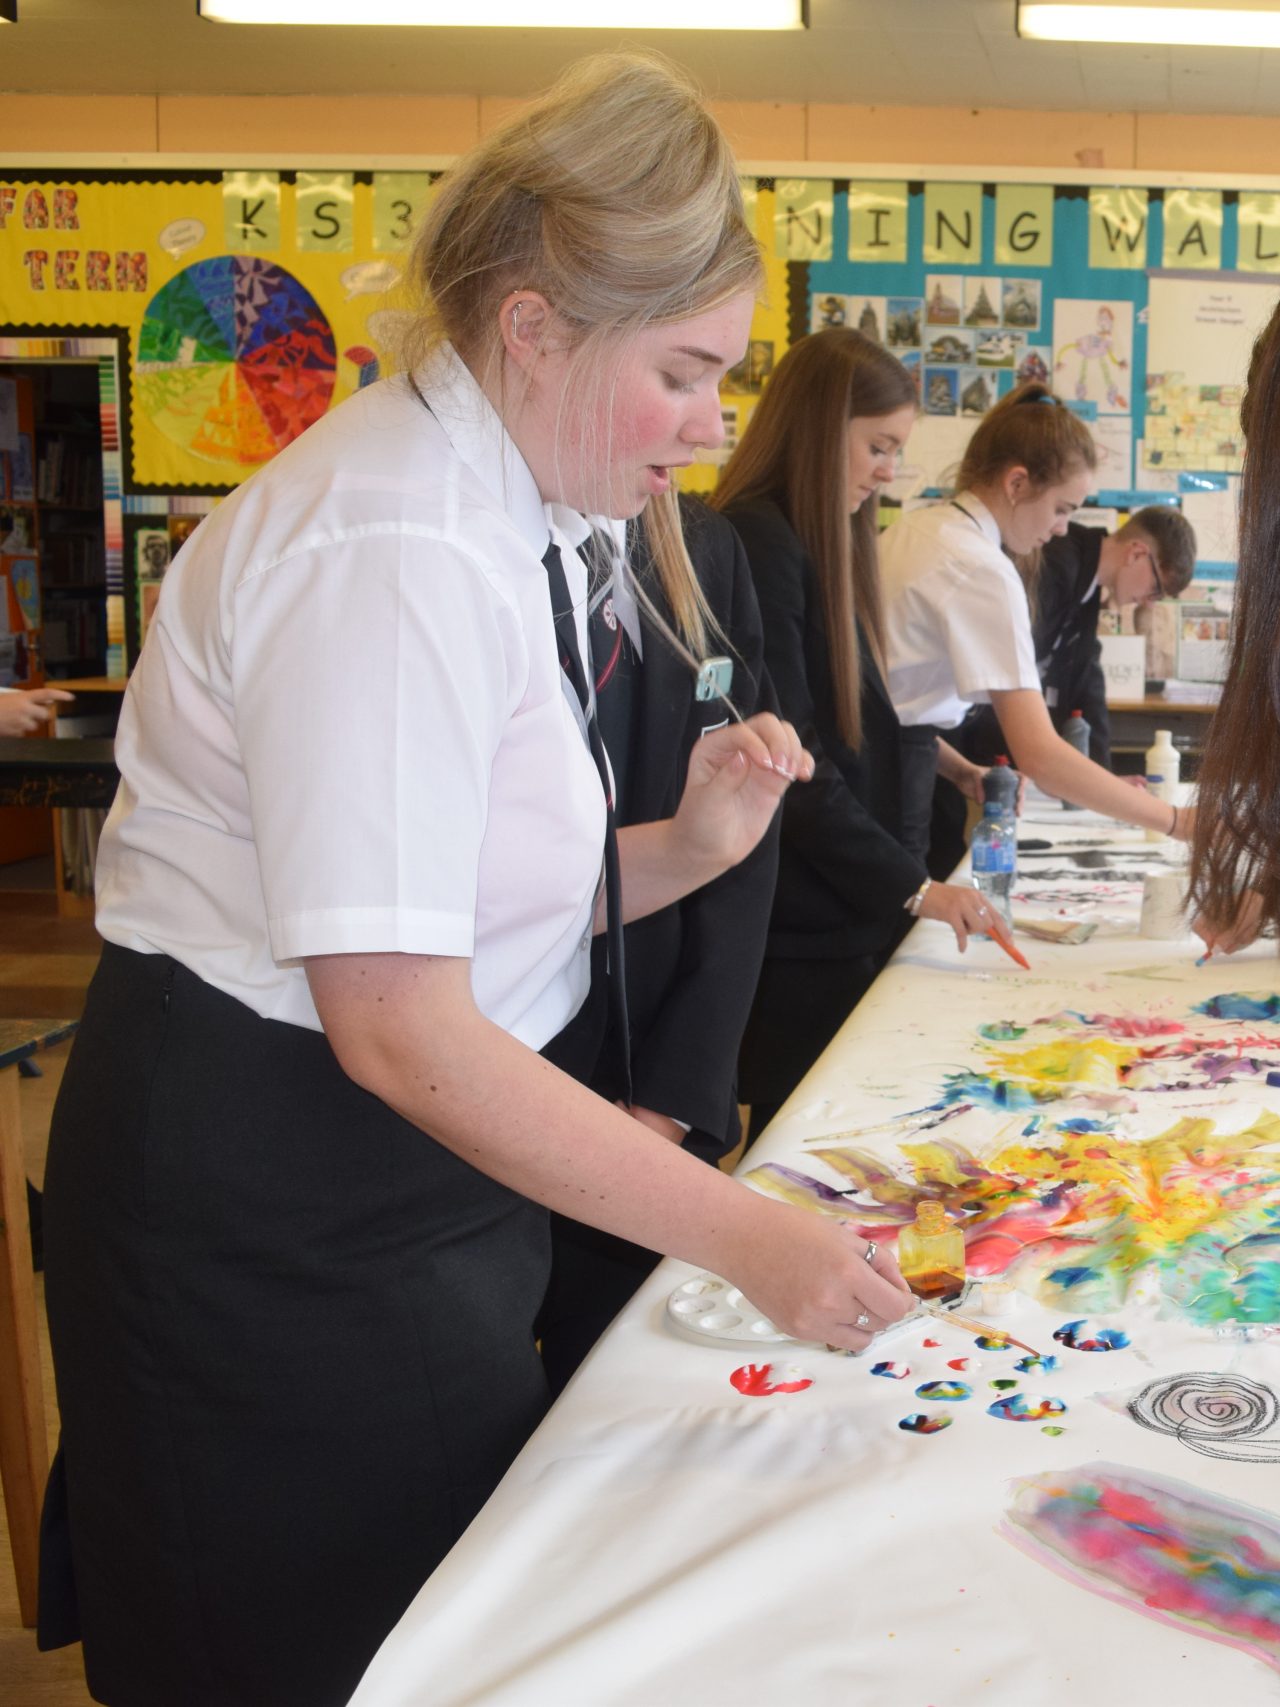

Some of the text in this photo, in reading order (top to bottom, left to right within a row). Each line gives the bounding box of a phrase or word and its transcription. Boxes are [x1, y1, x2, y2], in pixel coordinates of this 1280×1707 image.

[241, 199, 414, 240] KS3
[786, 205, 1040, 253] NING
[1102, 214, 1280, 260] WAL
[23, 249, 148, 293] TERM
